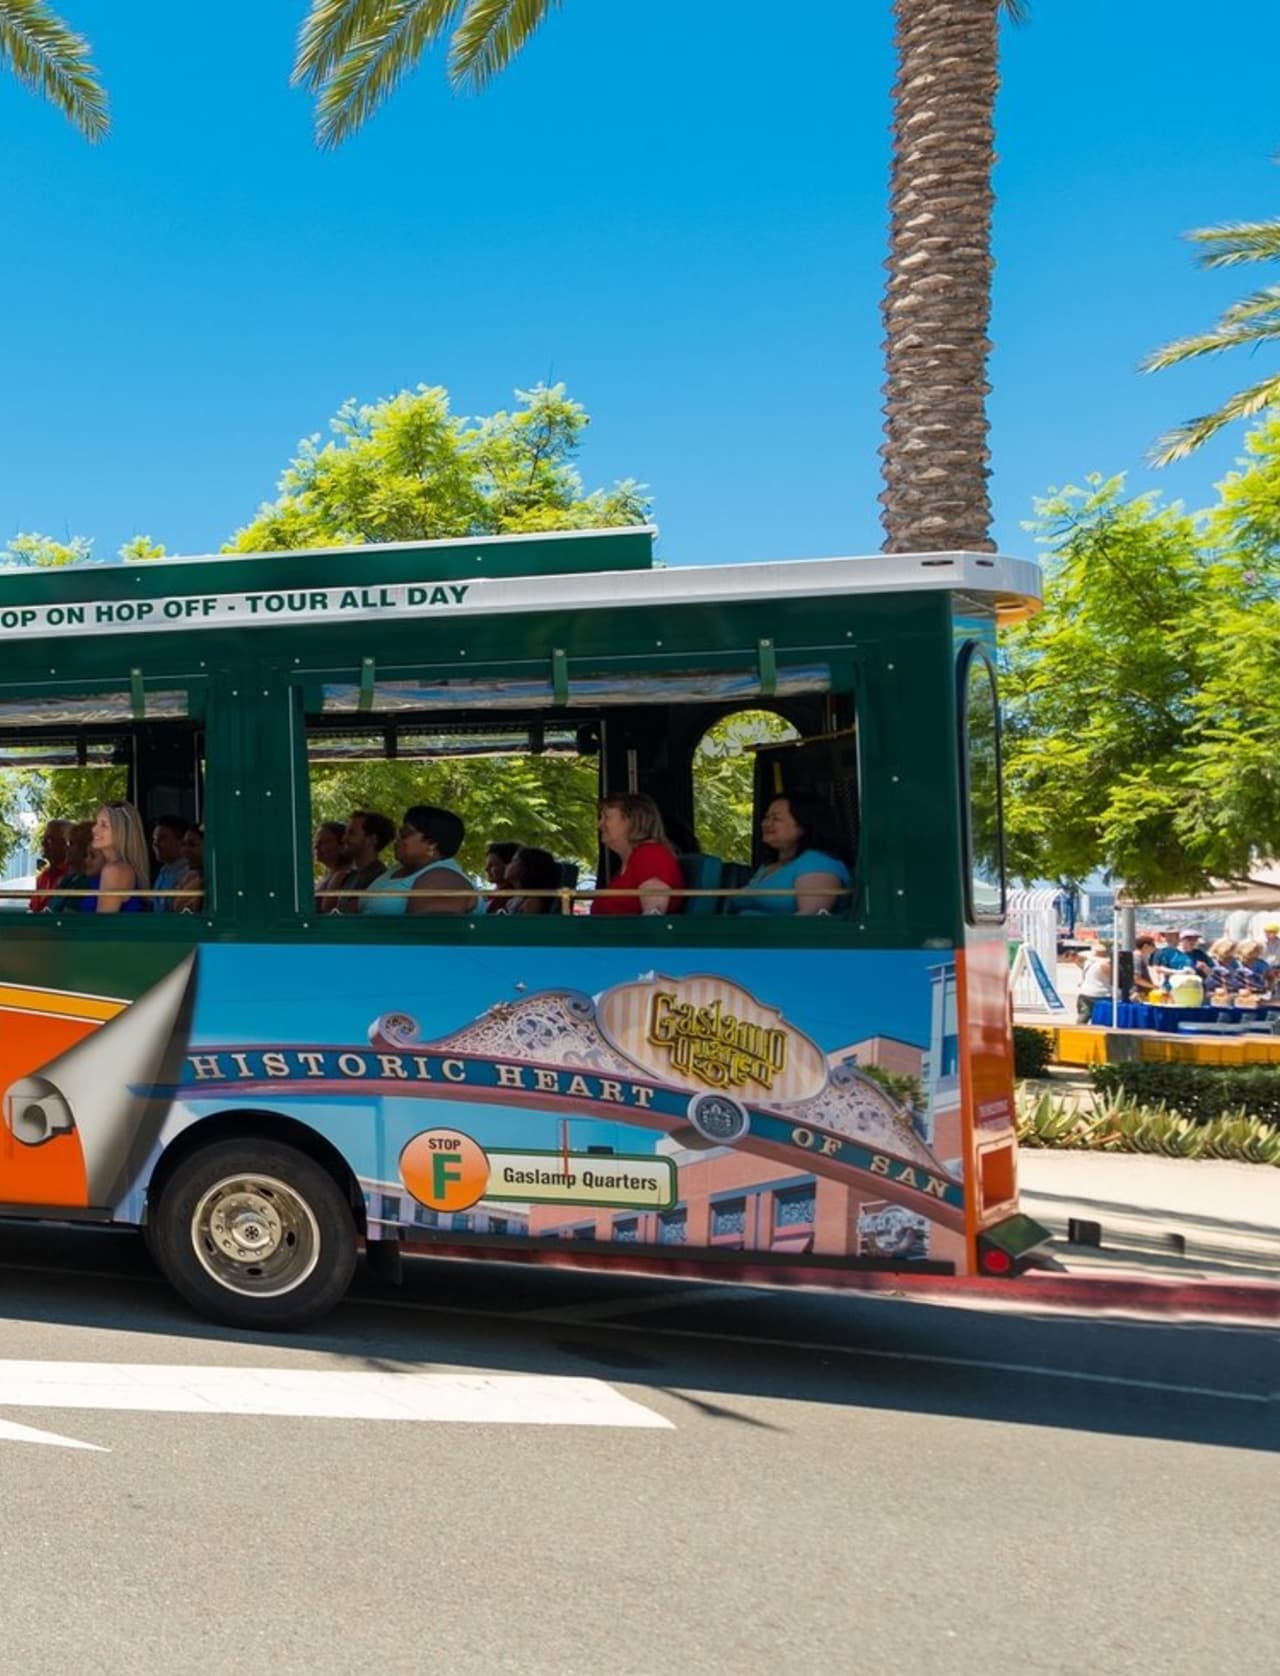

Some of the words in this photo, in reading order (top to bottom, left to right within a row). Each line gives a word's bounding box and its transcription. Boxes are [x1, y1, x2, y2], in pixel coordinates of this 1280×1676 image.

[46, 607, 85, 625] ON
[96, 602, 154, 622] HOP
[163, 598, 217, 618] OFF
[245, 592, 328, 613] TOUR
[340, 588, 396, 608] ALL
[407, 585, 470, 606] DAY
[188, 1052, 466, 1081] HISTORIC
[495, 1064, 654, 1109] HEART
[792, 1127, 843, 1156] OF
[868, 1155, 950, 1200] SAN
[428, 1137, 461, 1151] STOP
[432, 1152, 462, 1200] F
[503, 1166, 576, 1189] Gaslamp
[582, 1170, 659, 1192] Quarters
